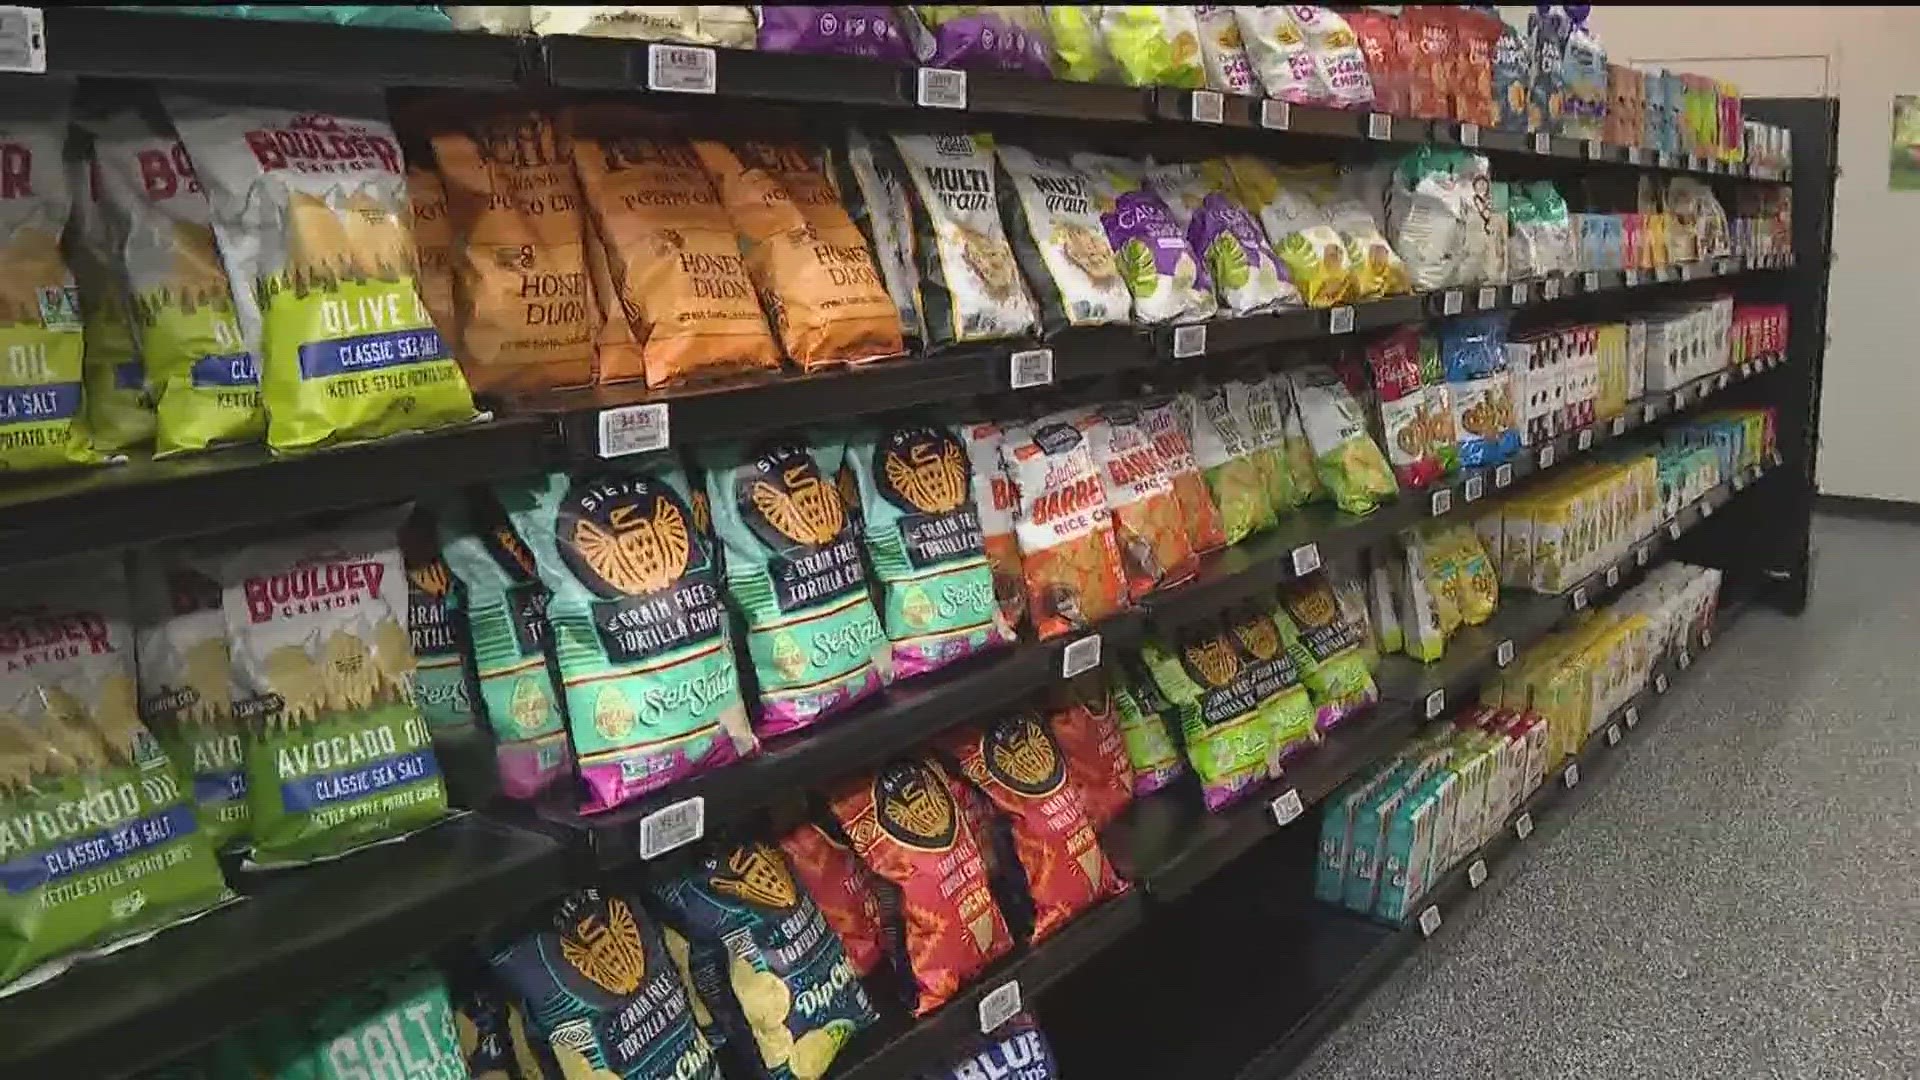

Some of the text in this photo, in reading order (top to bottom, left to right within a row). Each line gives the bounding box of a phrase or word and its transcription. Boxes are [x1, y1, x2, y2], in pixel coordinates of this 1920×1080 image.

[245, 129, 401, 175] BOULDER
[924, 167, 990, 193] MULTI
[1045, 192, 1089, 216] grain
[680, 251, 746, 276] HONEY
[320, 293, 402, 333] OLIVE
[8, 344, 56, 381] OIL
[339, 340, 395, 367] CLASSIC
[22, 390, 58, 416] SALT
[326, 377, 370, 400] KETTLE
[372, 372, 407, 394] STYLE
[1032, 474, 1107, 526] BARBE
[919, 516, 958, 538] GRAIN
[1053, 515, 1089, 536] RICE
[794, 550, 834, 578] GRAIN
[244, 562, 385, 625] BOULDER
[788, 567, 844, 601] TORTILLA
[281, 594, 361, 618] CANYON
[618, 584, 711, 630] GRAIN FREE
[411, 628, 455, 650] RTILL
[616, 618, 688, 652] TORTILLA
[7, 644, 80, 674] ANYON
[640, 662, 733, 727] Sea Salt
[277, 724, 397, 779] AVOCADO
[404, 715, 432, 748] OIL
[315, 756, 425, 801] CLASSIC SEA SALT
[0, 782, 141, 852] AVOCADO
[45, 815, 173, 876] CLASSIC SEA SALT
[40, 880, 90, 911] KETTLE
[86, 868, 123, 894] STYLE
[619, 994, 654, 1033] GRAIN
[795, 980, 834, 1019] Dip
[328, 999, 443, 1080] SALT
[616, 1009, 668, 1063] TORTILLA
[952, 1030, 1046, 1080] BLUE
